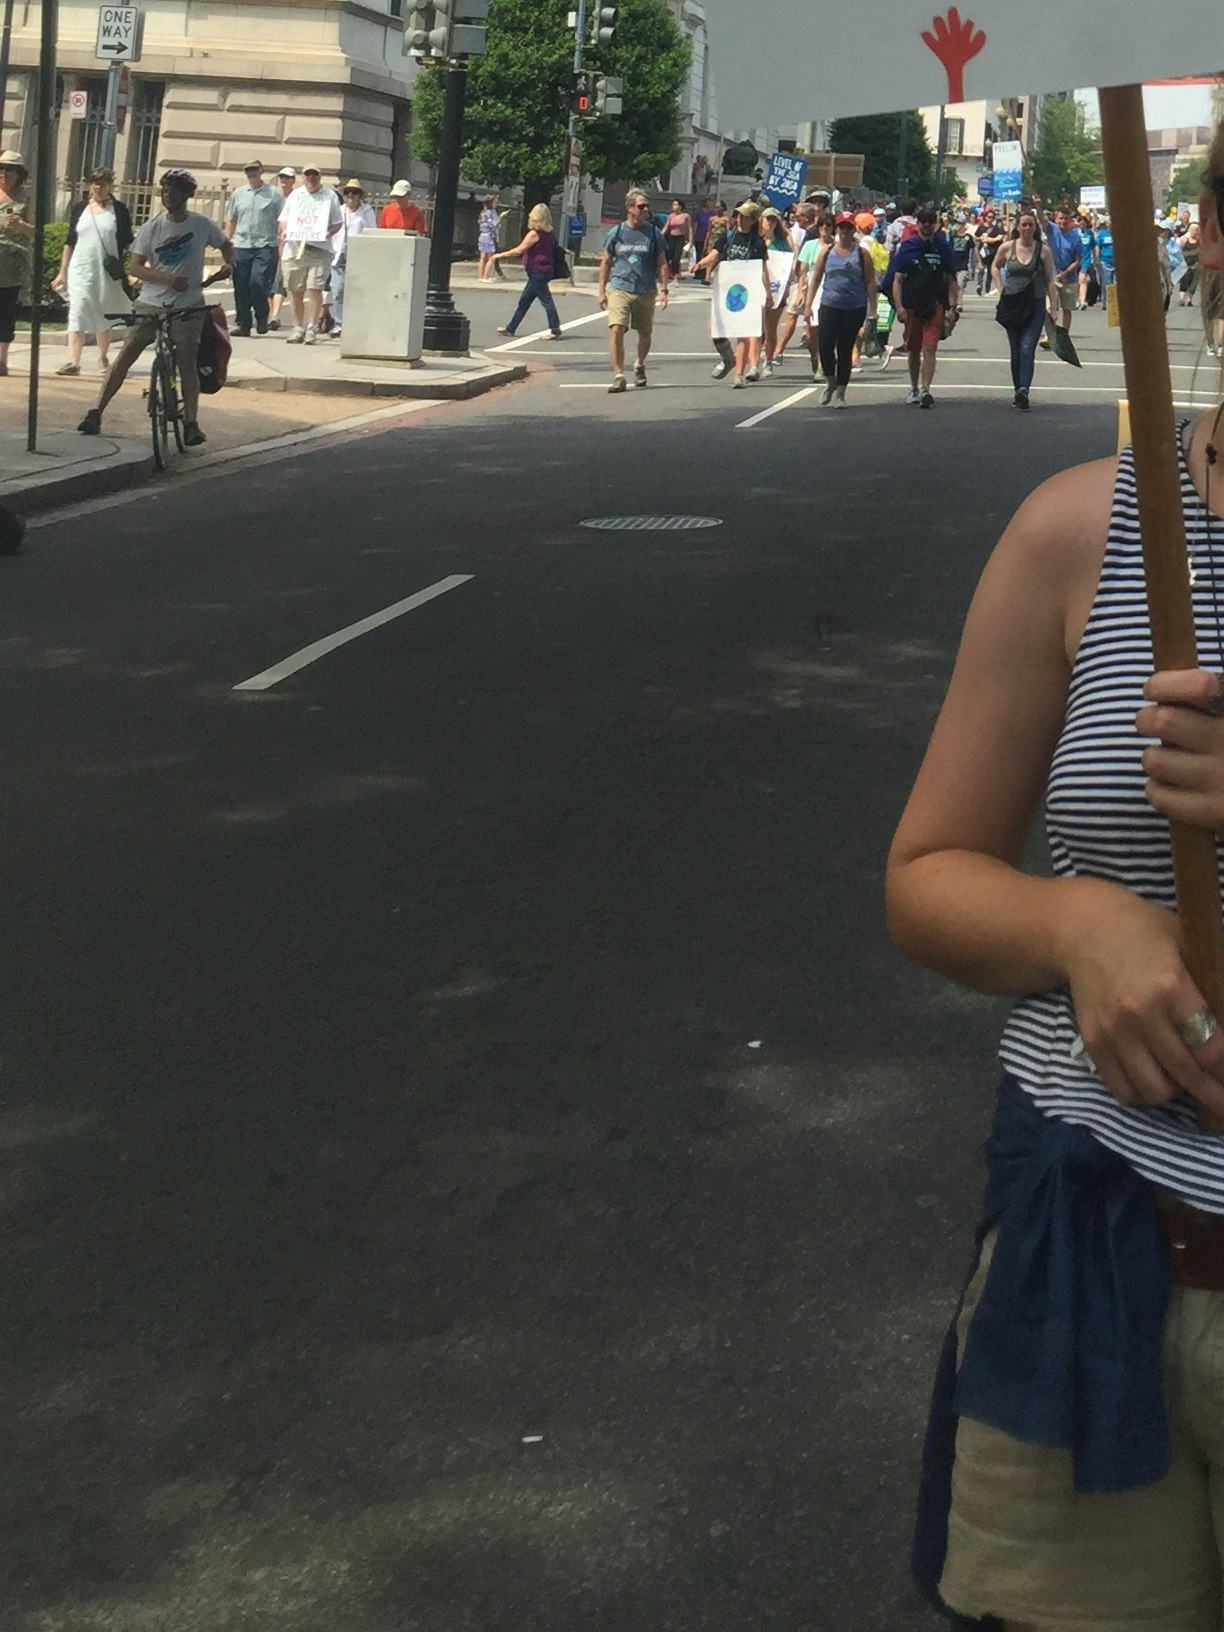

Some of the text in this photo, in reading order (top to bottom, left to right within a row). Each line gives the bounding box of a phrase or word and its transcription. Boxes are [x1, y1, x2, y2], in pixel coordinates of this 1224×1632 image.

[104, 10, 132, 24] ONE
[102, 24, 132, 38] WAY
[773, 156, 792, 170] LEVEL
[769, 175, 781, 186] BY
